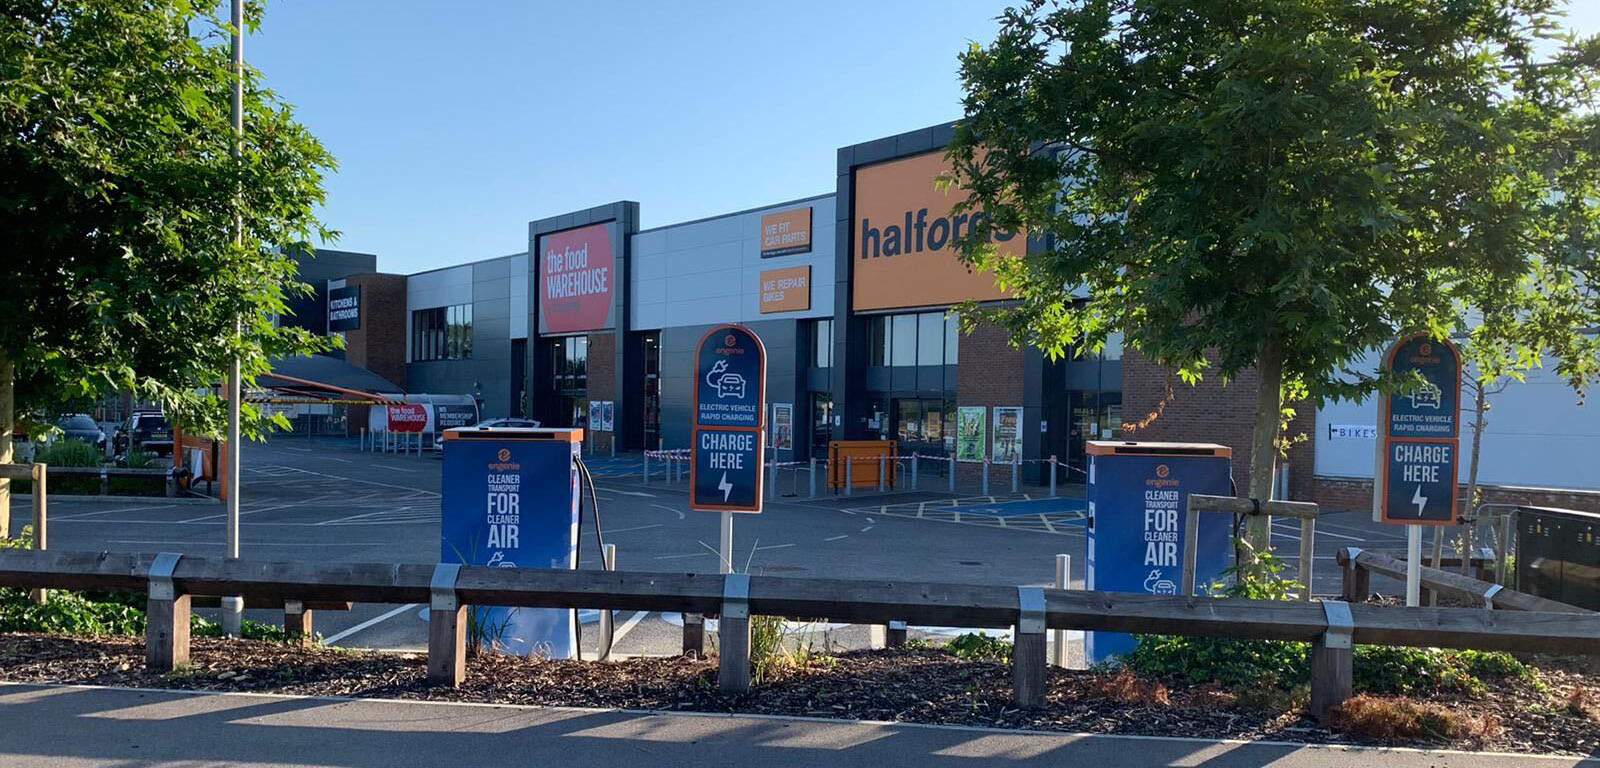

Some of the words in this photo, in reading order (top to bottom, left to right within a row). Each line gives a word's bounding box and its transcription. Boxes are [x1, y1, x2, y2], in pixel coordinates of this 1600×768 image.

[765, 224, 778, 235] WE
[779, 221, 791, 233] FIT
[782, 230, 807, 244] PARTS
[547, 249, 563, 273] the
[565, 242, 588, 271] food
[546, 267, 608, 299] WAREHOUSE
[763, 280, 776, 292] WE
[778, 276, 806, 290] REPAIR
[330, 297, 353, 310] KITCHENS
[763, 290, 785, 303] BIKES
[330, 307, 359, 321] BATHROOMS
[699, 403, 729, 411] ELECTRIC
[731, 404, 756, 412] VEHICLE
[701, 412, 720, 420] RAPID
[721, 413, 755, 421] CHARGING
[1392, 414, 1424, 422] ELECTRIC
[1425, 415, 1453, 423] VEHICLE
[1340, 427, 1377, 437] BIKES
[1393, 424, 1415, 432] RAPID
[1416, 424, 1451, 433] CHARGING
[701, 433, 754, 452] CHARGE
[709, 451, 744, 470] HERE
[1395, 445, 1450, 463] CHARGE
[487, 474, 521, 484] CLEANER
[1403, 464, 1440, 482] HERE
[487, 484, 520, 492] TRANSPORT
[1145, 490, 1179, 500] CLEANER
[487, 492, 520, 515] FOR
[1144, 500, 1178, 509] TRANSPORT
[487, 514, 520, 525] CLEANER
[1144, 509, 1178, 532] FOR
[487, 524, 519, 549] AIR
[1144, 531, 1178, 542] CLEANER
[1144, 541, 1177, 567] AIR
